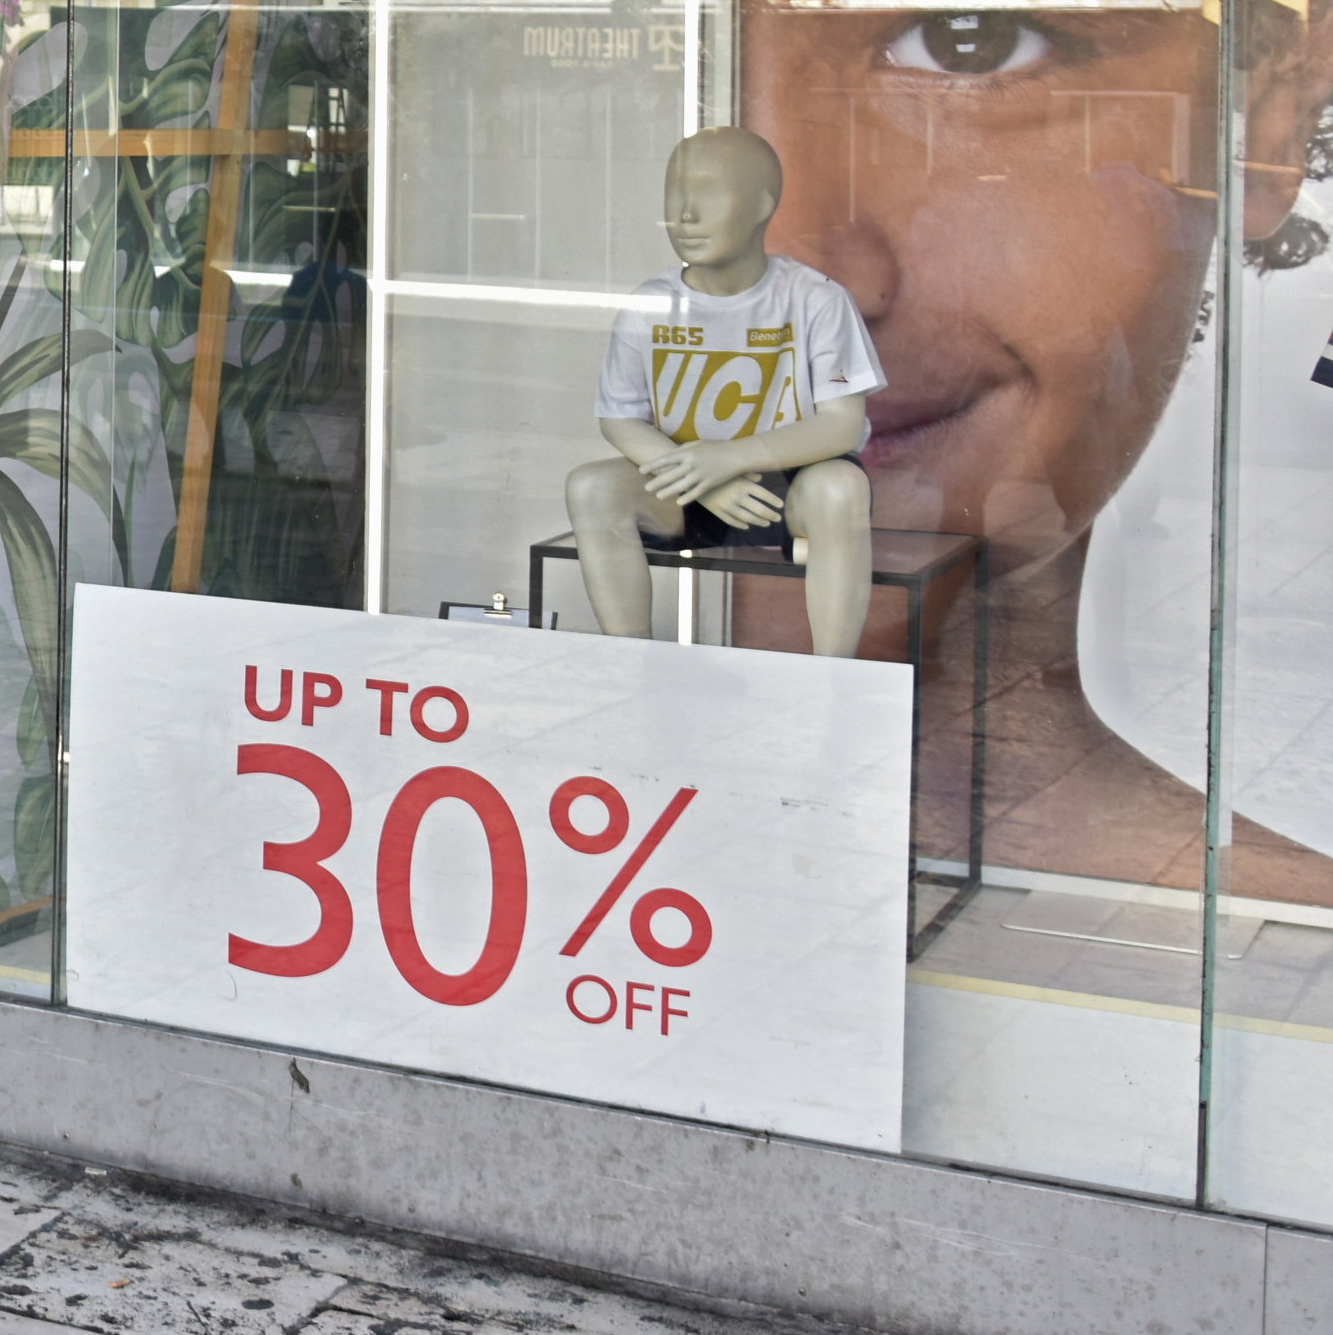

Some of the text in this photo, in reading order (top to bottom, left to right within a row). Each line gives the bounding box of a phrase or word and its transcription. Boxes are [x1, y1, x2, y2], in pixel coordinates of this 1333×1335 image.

[244, 664, 470, 744] UP TO
[227, 742, 713, 1007] 30%
[565, 973, 691, 1037] OFF
